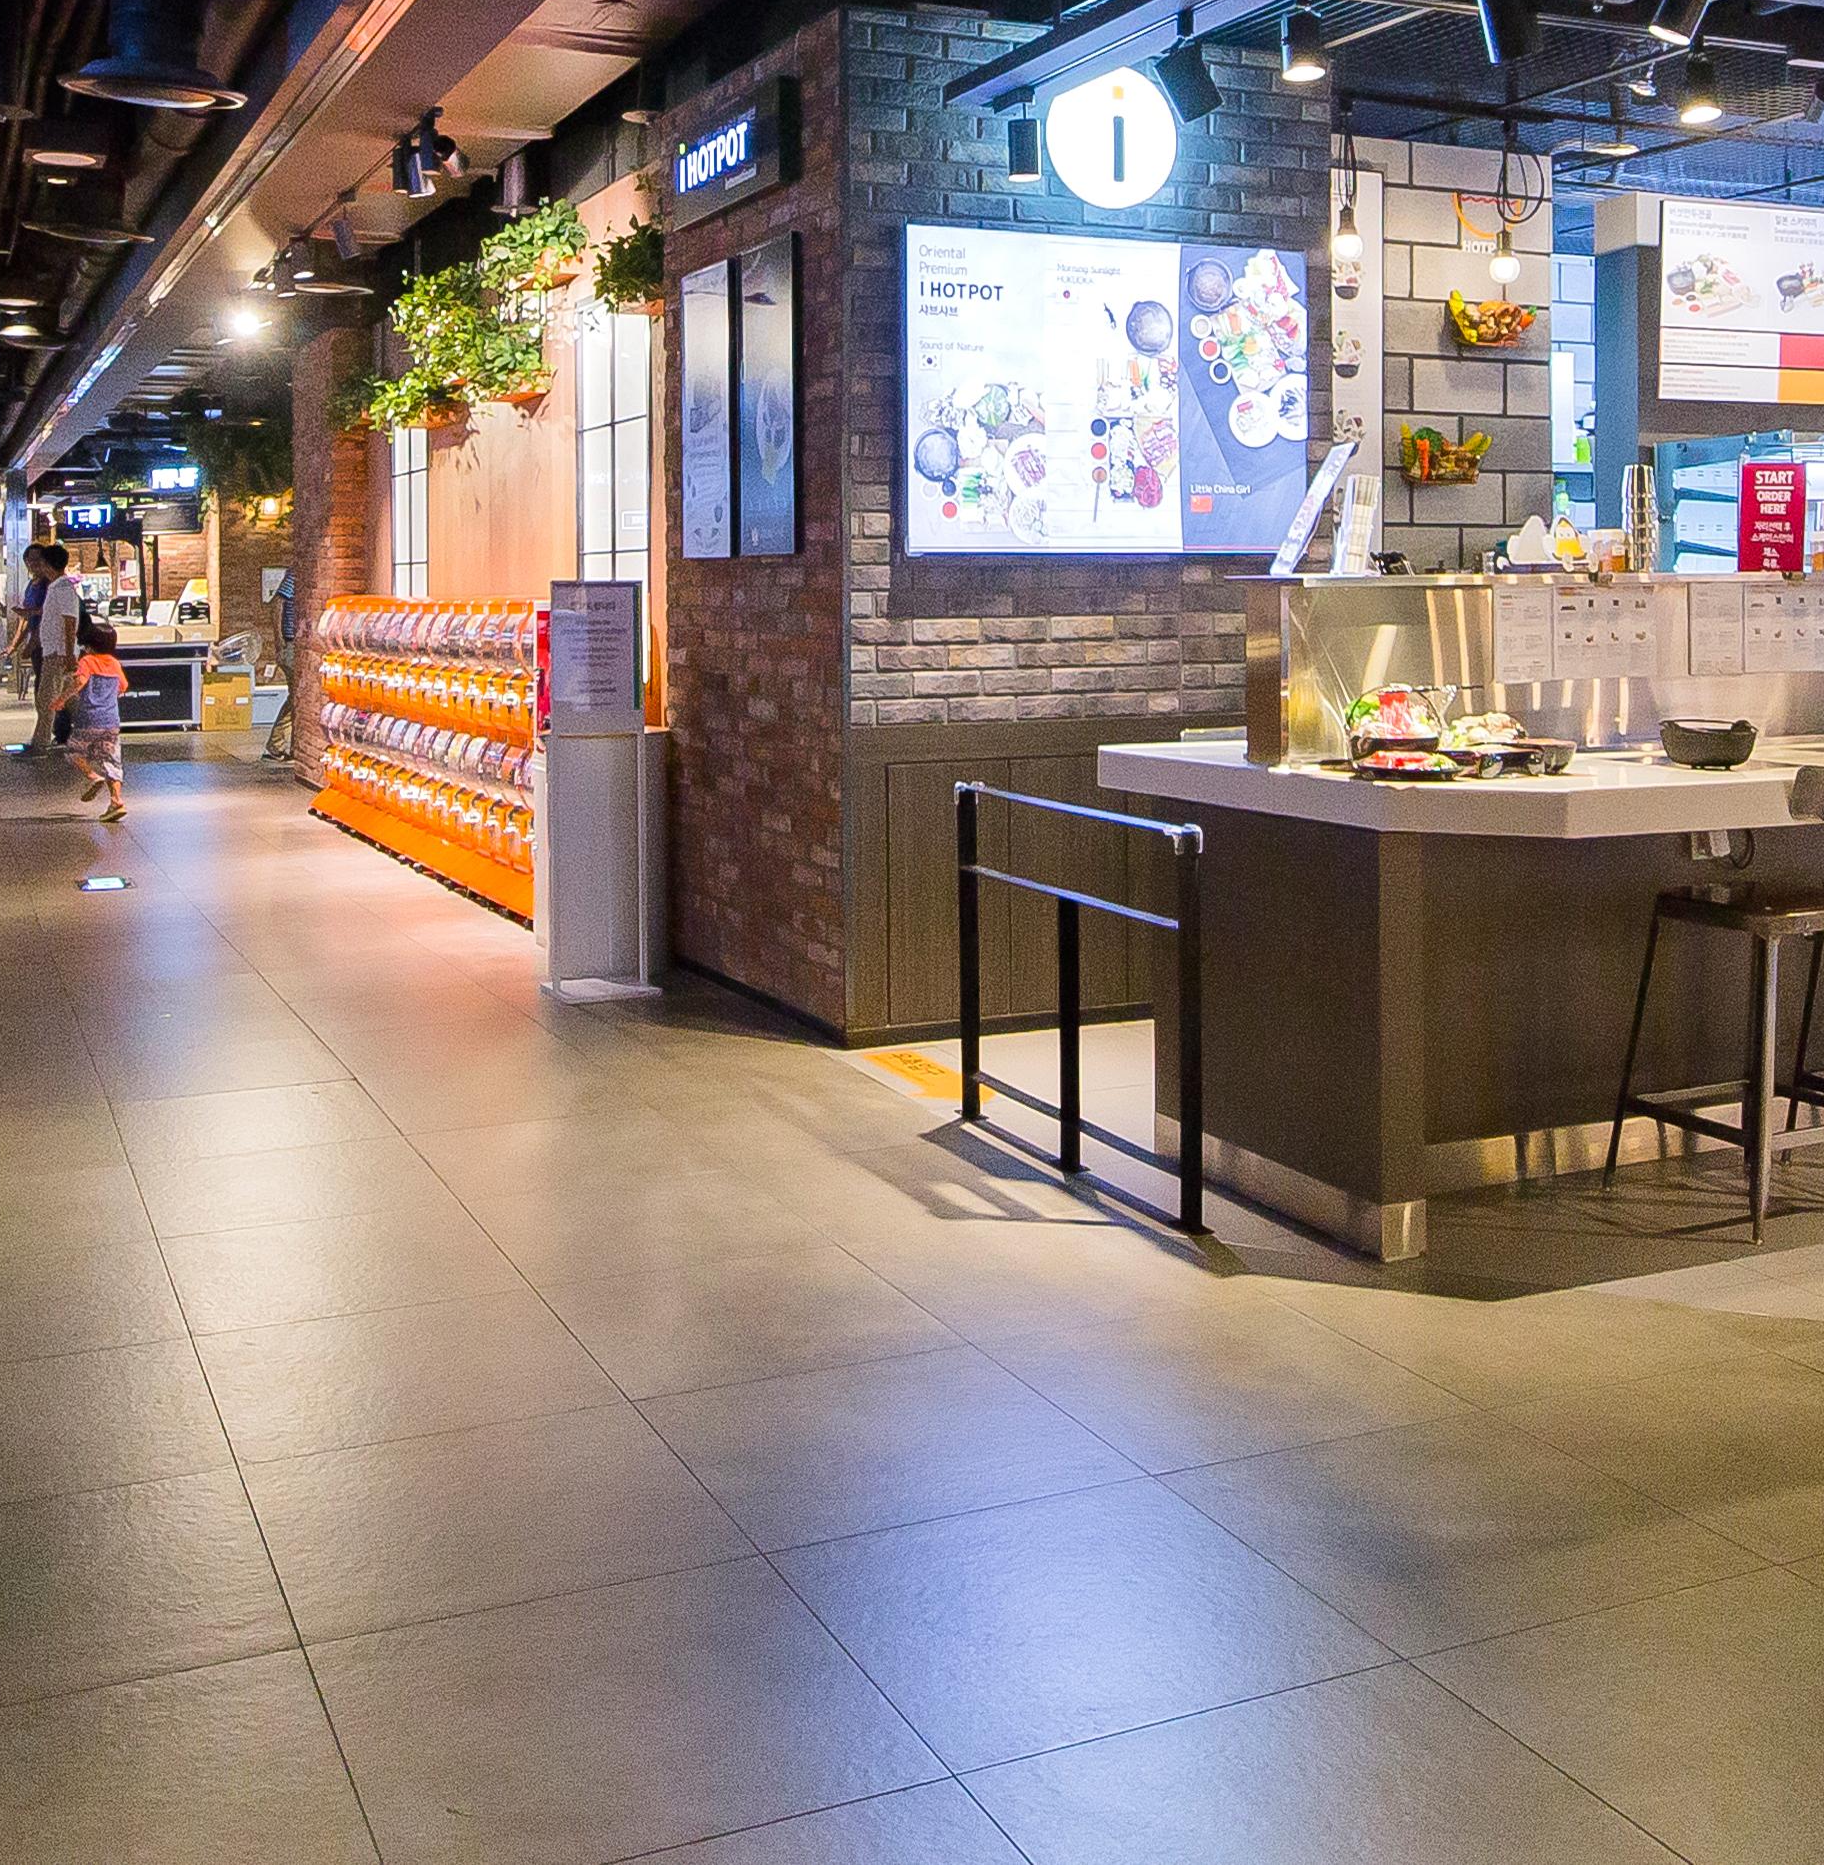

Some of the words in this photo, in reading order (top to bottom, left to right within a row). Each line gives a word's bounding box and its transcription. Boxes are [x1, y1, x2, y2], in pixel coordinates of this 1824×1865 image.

[687, 121, 748, 190] HOTPOT
[919, 244, 966, 259] Oriental
[919, 261, 968, 276] Premium
[930, 281, 1004, 301] HOTPOT
[918, 304, 959, 317] 샤브샤브
[919, 340, 943, 350] Sound
[945, 341, 954, 350] of
[957, 342, 984, 352] Nature
[1755, 470, 1794, 484] START
[1190, 484, 1212, 494] Little
[1213, 484, 1235, 494] China
[1235, 484, 1252, 494] Girl
[1756, 491, 1792, 502] ORDER
[1760, 503, 1787, 514] HERE
